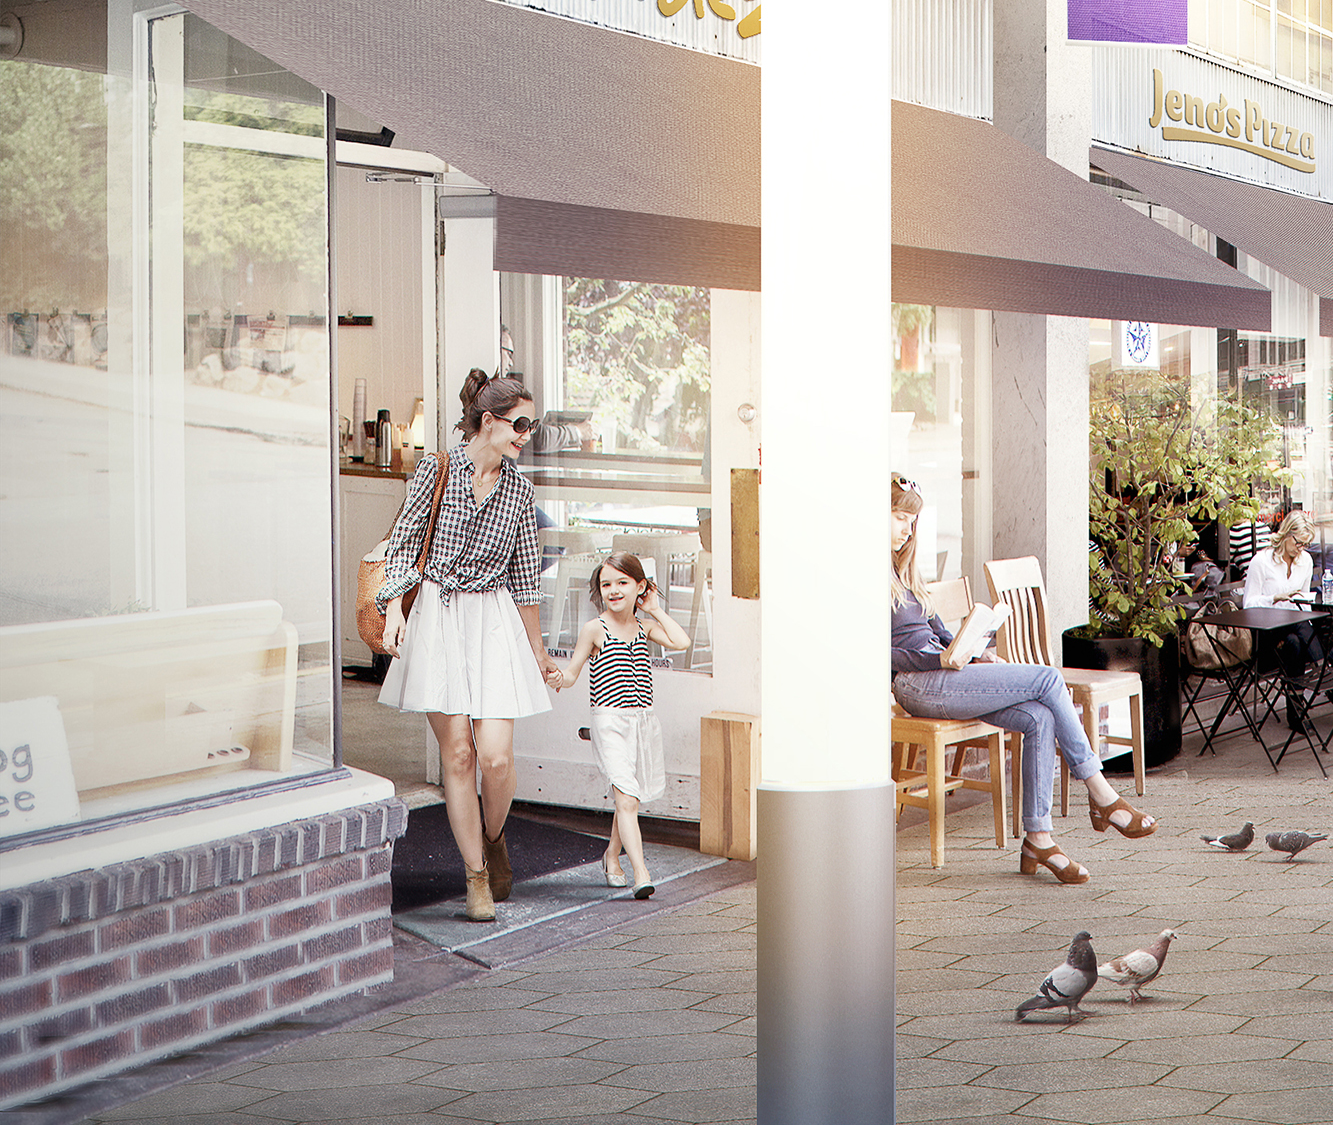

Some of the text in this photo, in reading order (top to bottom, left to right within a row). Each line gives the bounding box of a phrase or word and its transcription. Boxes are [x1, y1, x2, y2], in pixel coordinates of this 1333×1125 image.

[1149, 68, 1316, 160] Jeno's Pizza
[1257, 508, 1285, 523] merci
[547, 647, 568, 659] REMAIN
